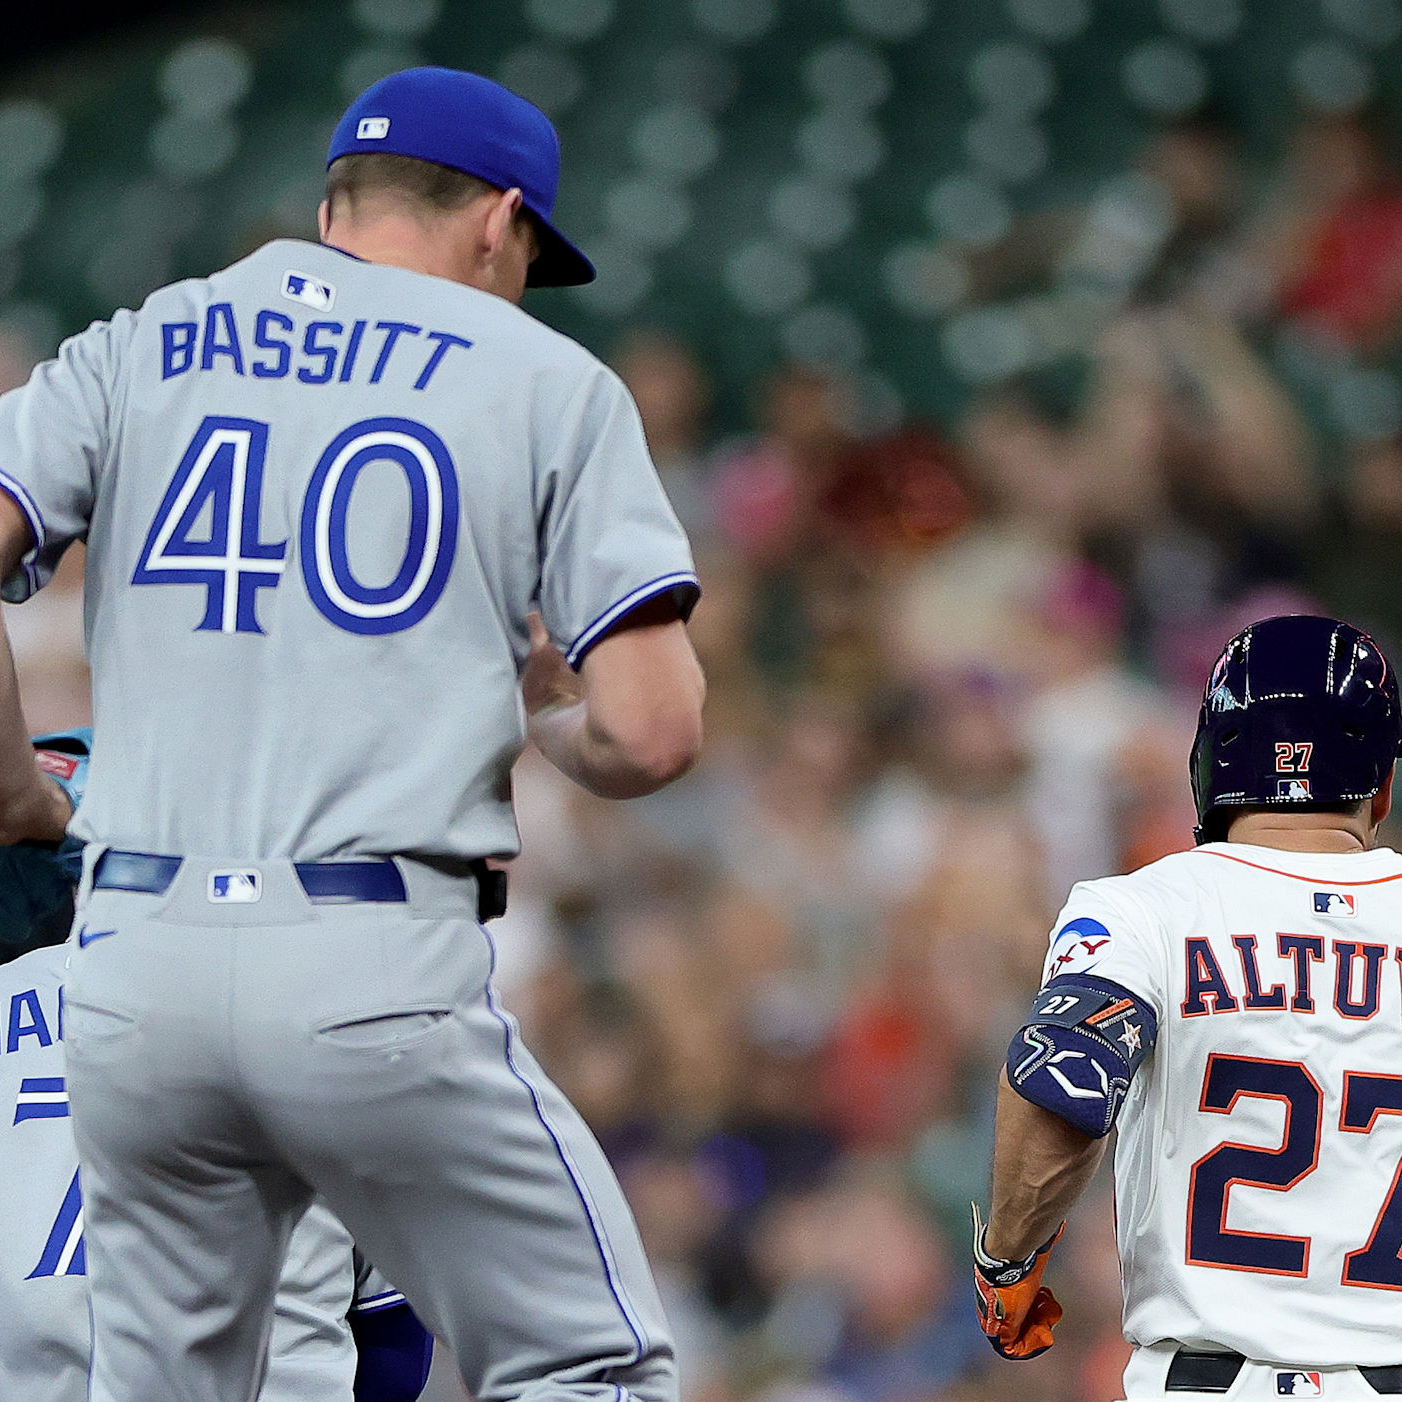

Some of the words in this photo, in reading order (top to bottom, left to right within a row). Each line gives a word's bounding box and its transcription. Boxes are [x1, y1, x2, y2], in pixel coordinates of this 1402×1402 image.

[162, 302, 473, 390] BASSITT
[130, 415, 460, 636] 40
[1275, 742, 1313, 772] 27
[1039, 995, 1080, 1015] 27
